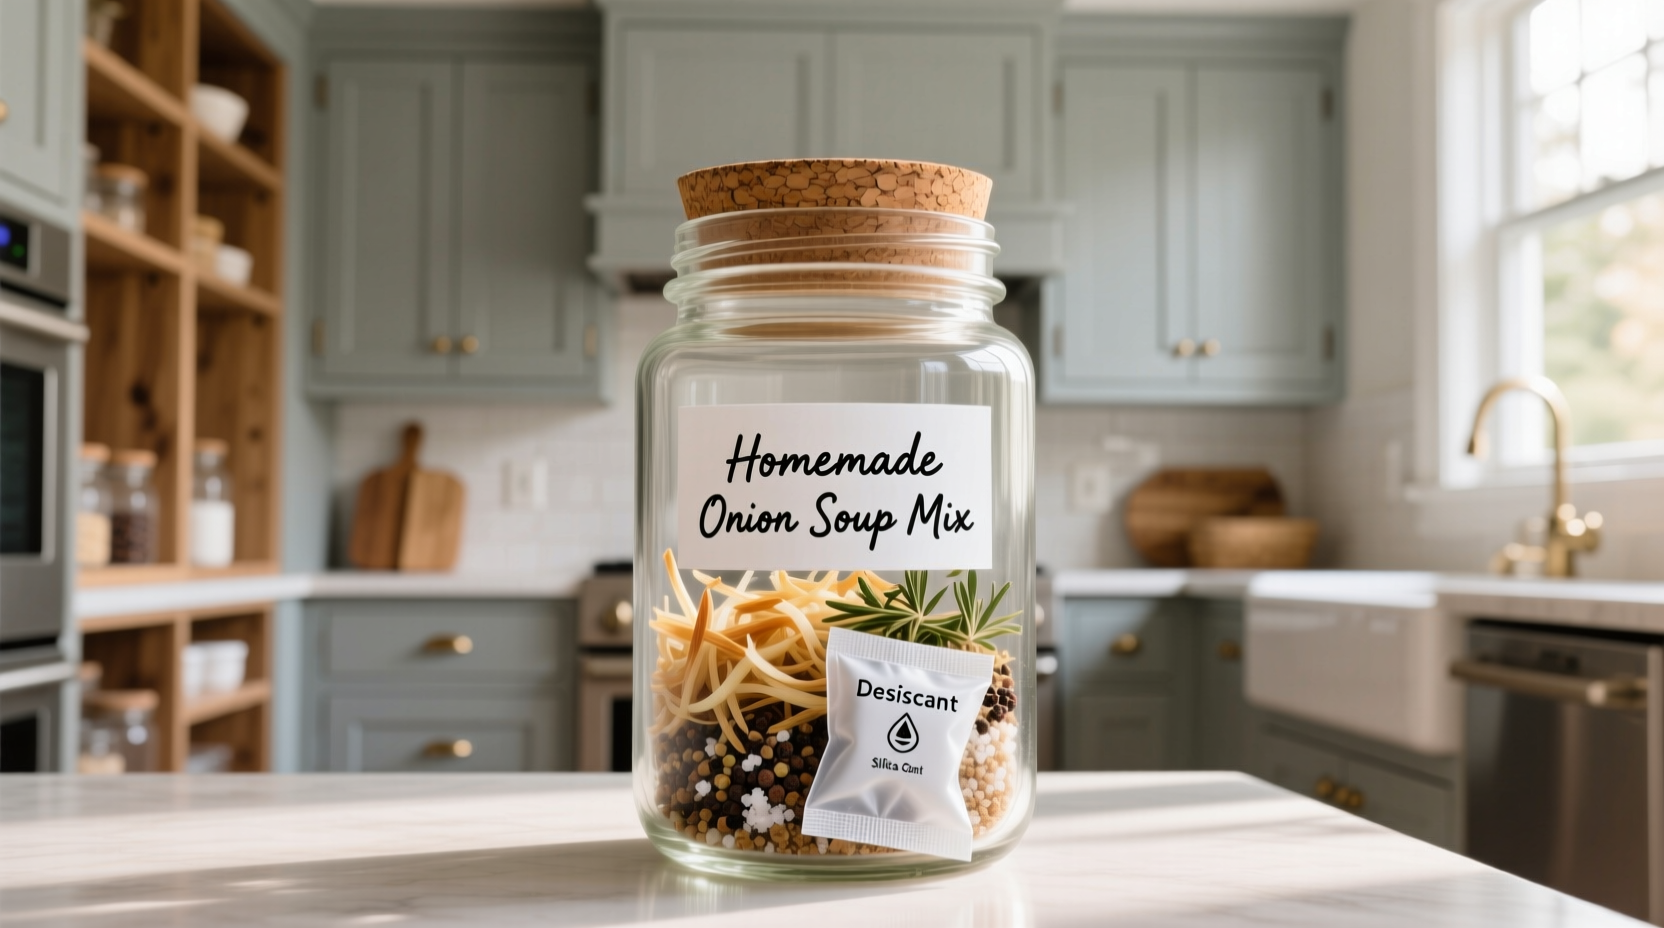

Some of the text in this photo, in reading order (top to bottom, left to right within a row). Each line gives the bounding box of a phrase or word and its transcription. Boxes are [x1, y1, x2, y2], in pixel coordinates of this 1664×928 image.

[726, 431, 943, 483] Homemade
[699, 492, 974, 551] Onion Soup Mix
[857, 679, 959, 713] Desiscant
